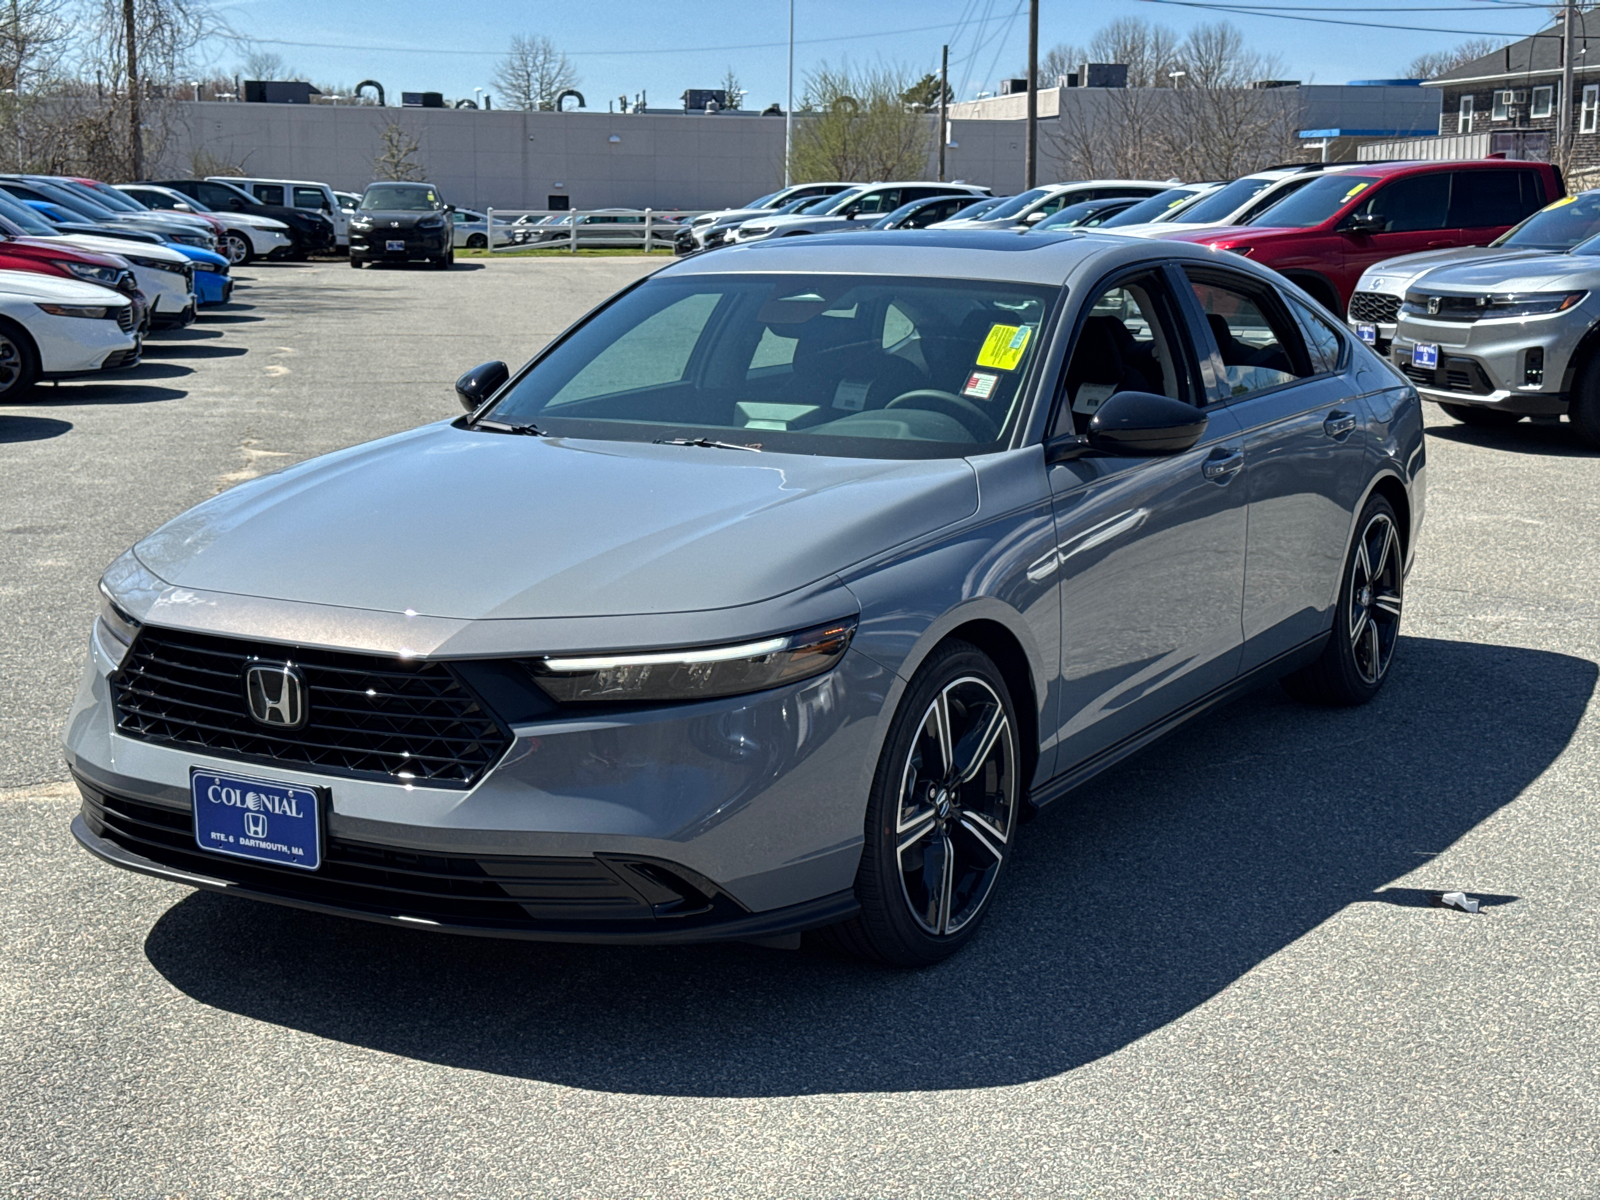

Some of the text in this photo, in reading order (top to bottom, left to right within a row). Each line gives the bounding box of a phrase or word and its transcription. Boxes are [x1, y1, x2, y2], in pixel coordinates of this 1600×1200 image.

[207, 785, 304, 818] COLONIAL
[210, 831, 305, 856] RTE. 6 DARTMOUTH, MA
